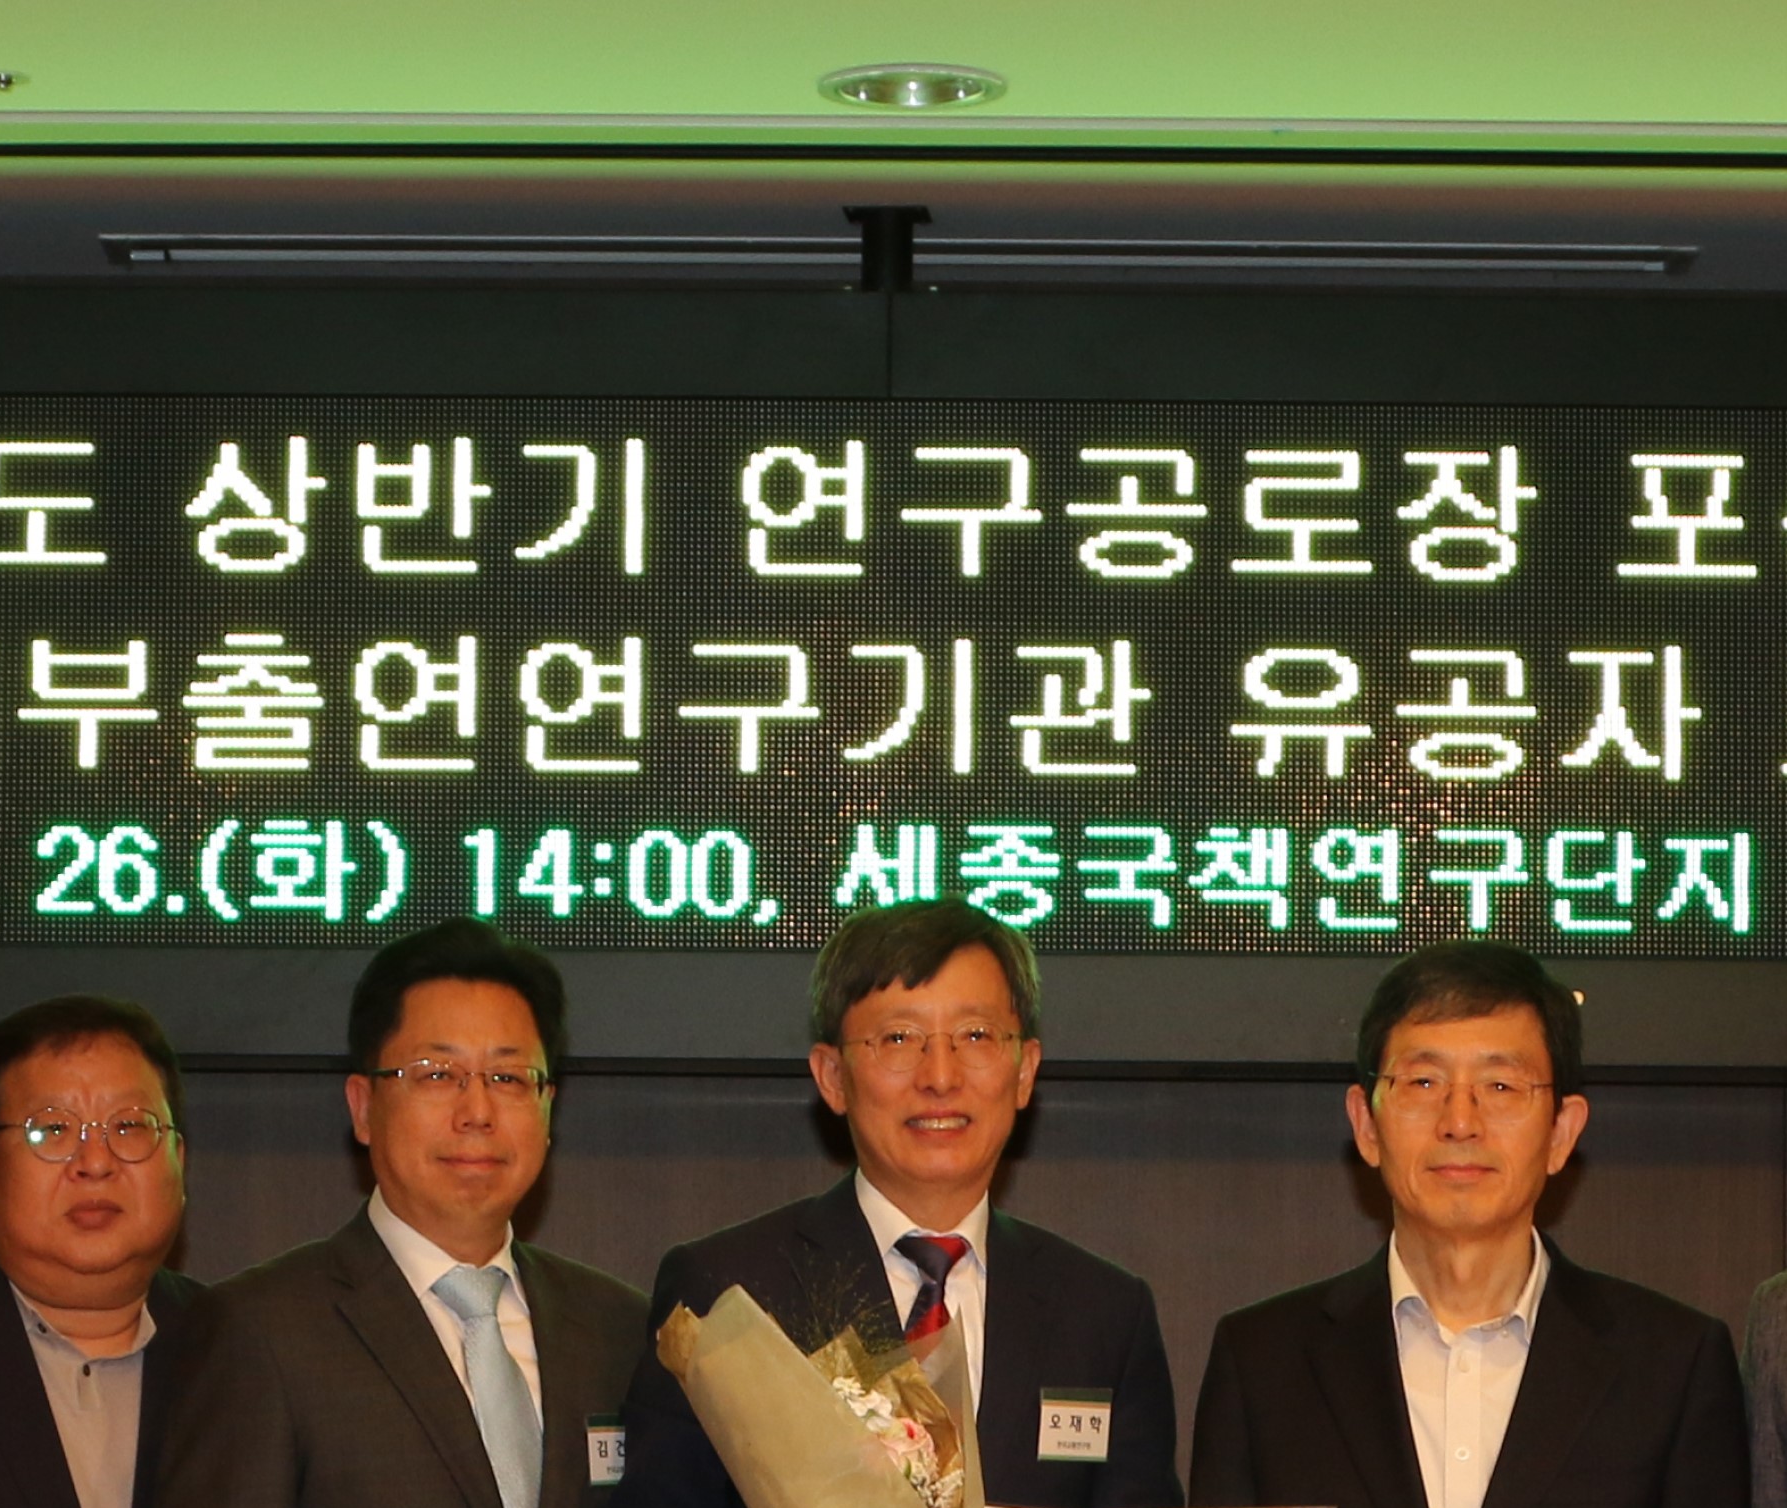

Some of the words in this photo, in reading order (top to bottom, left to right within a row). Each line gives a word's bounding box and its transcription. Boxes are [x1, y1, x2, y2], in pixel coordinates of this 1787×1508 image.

[184, 435, 646, 576] 상반기
[740, 438, 1539, 583] 연구공로장
[1229, 644, 1703, 783] 유공자
[35, 818, 408, 924] 26.(화)
[463, 827, 780, 927] 14:00,
[834, 822, 1752, 935] 세종국책연구단지
